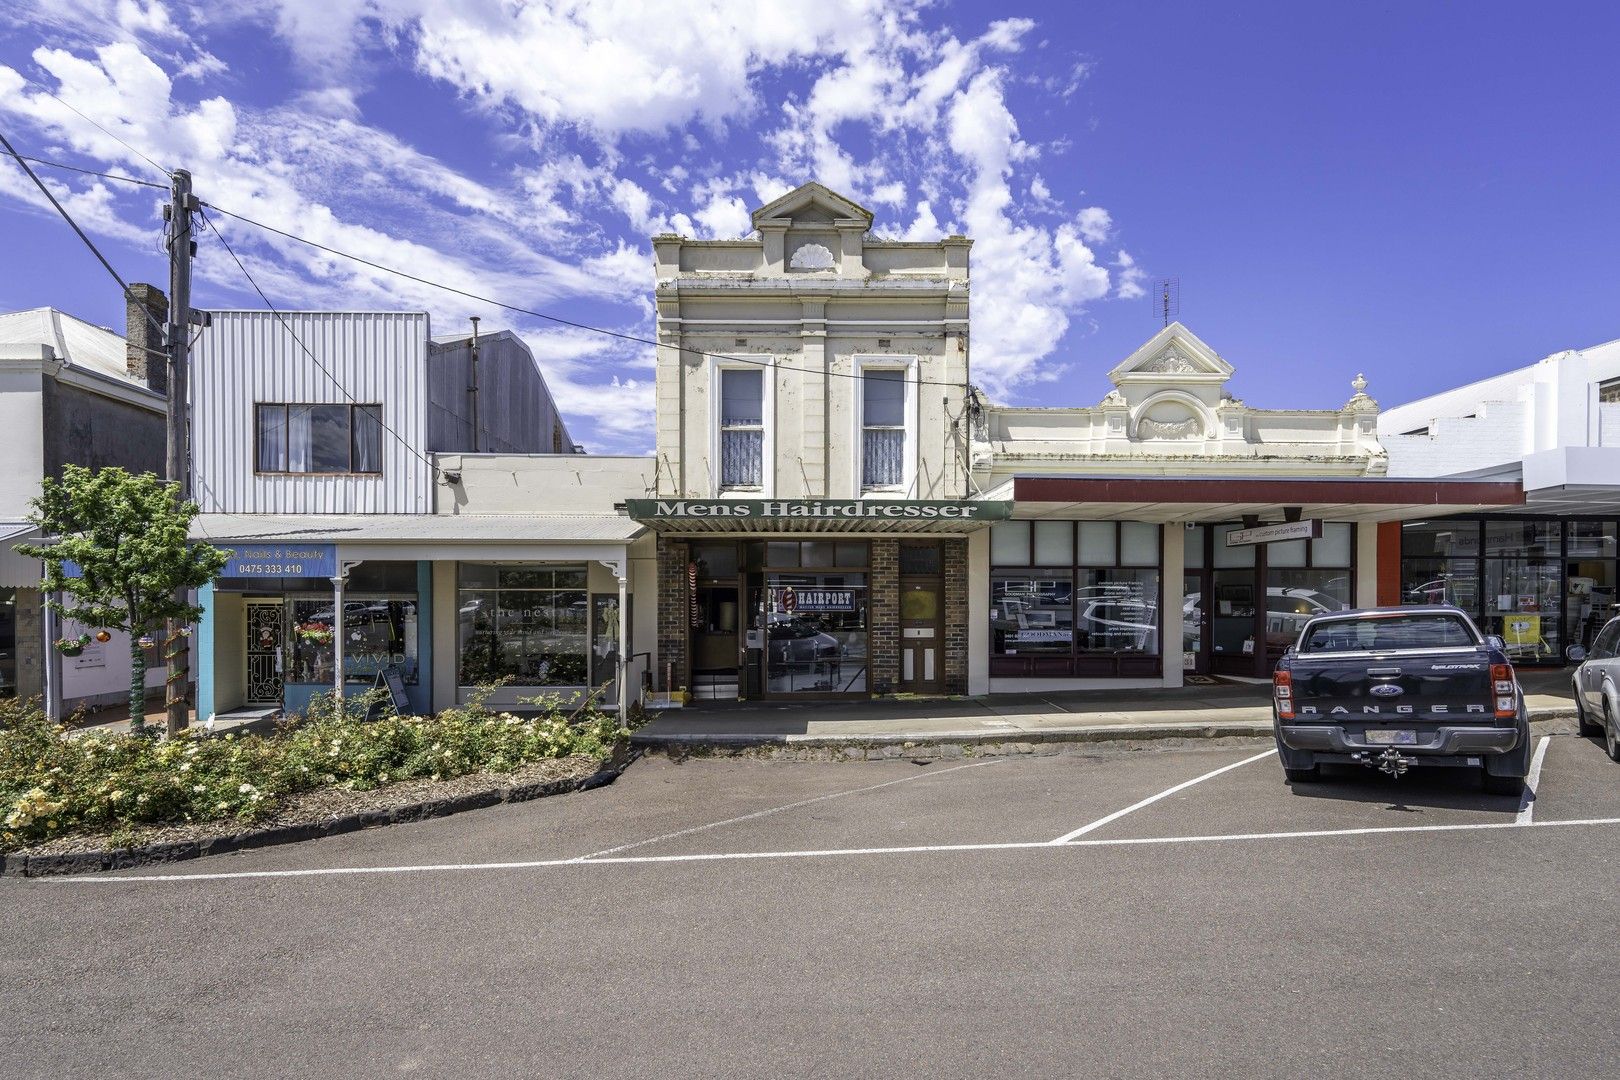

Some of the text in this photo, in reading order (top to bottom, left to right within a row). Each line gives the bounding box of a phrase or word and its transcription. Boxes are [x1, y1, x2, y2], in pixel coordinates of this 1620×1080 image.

[654, 500, 978, 518] Mens Hairdresser
[245, 550, 271, 559] Nails
[275, 550, 282, 559] &
[286, 550, 324, 560] Beauty
[239, 564, 302, 574] 0475 333 410
[798, 592, 851, 605] HAIRPORT
[490, 607, 556, 617] the nest
[352, 654, 406, 664] VIVID
[1301, 704, 1486, 714] RANGER
